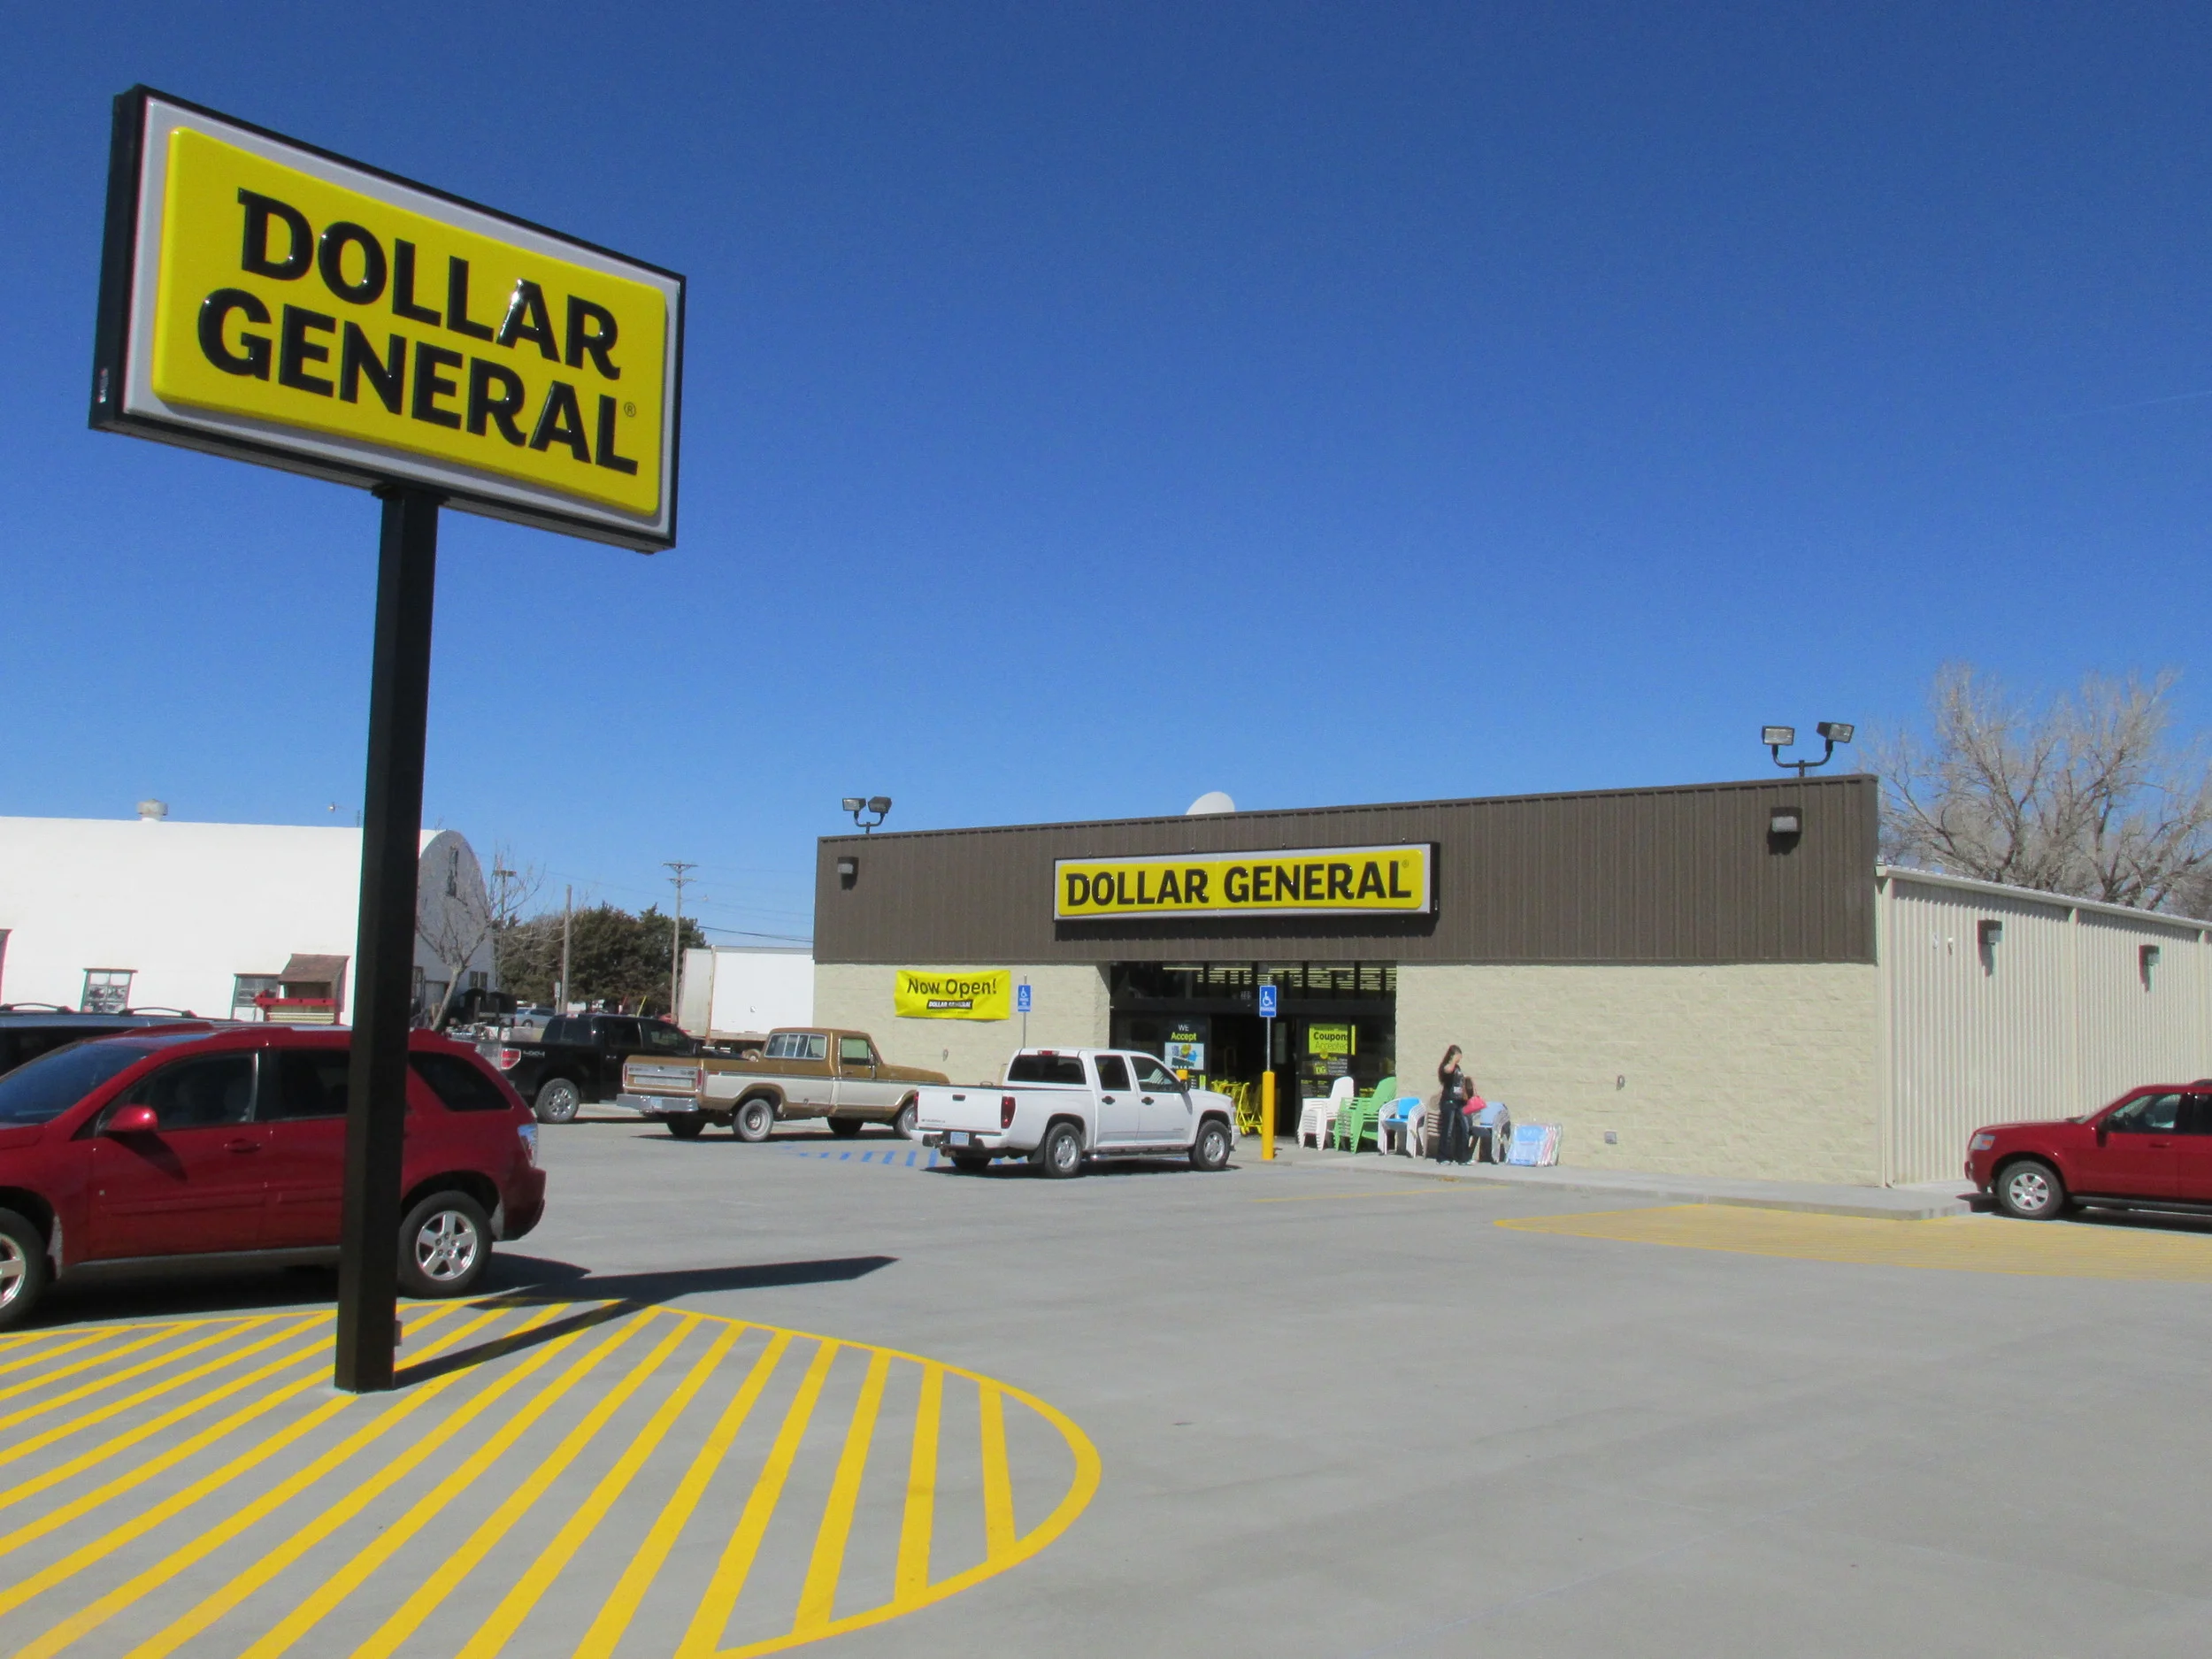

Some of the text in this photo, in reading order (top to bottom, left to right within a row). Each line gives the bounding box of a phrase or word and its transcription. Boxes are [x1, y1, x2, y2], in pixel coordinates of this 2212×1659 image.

[236, 186, 621, 381] DOLLAR
[197, 288, 639, 476] GENERAL
[1065, 860, 1412, 907] DOLLAR GENERAL
[907, 978, 997, 998] Now Open!
[1171, 1032, 1197, 1042] Accept
